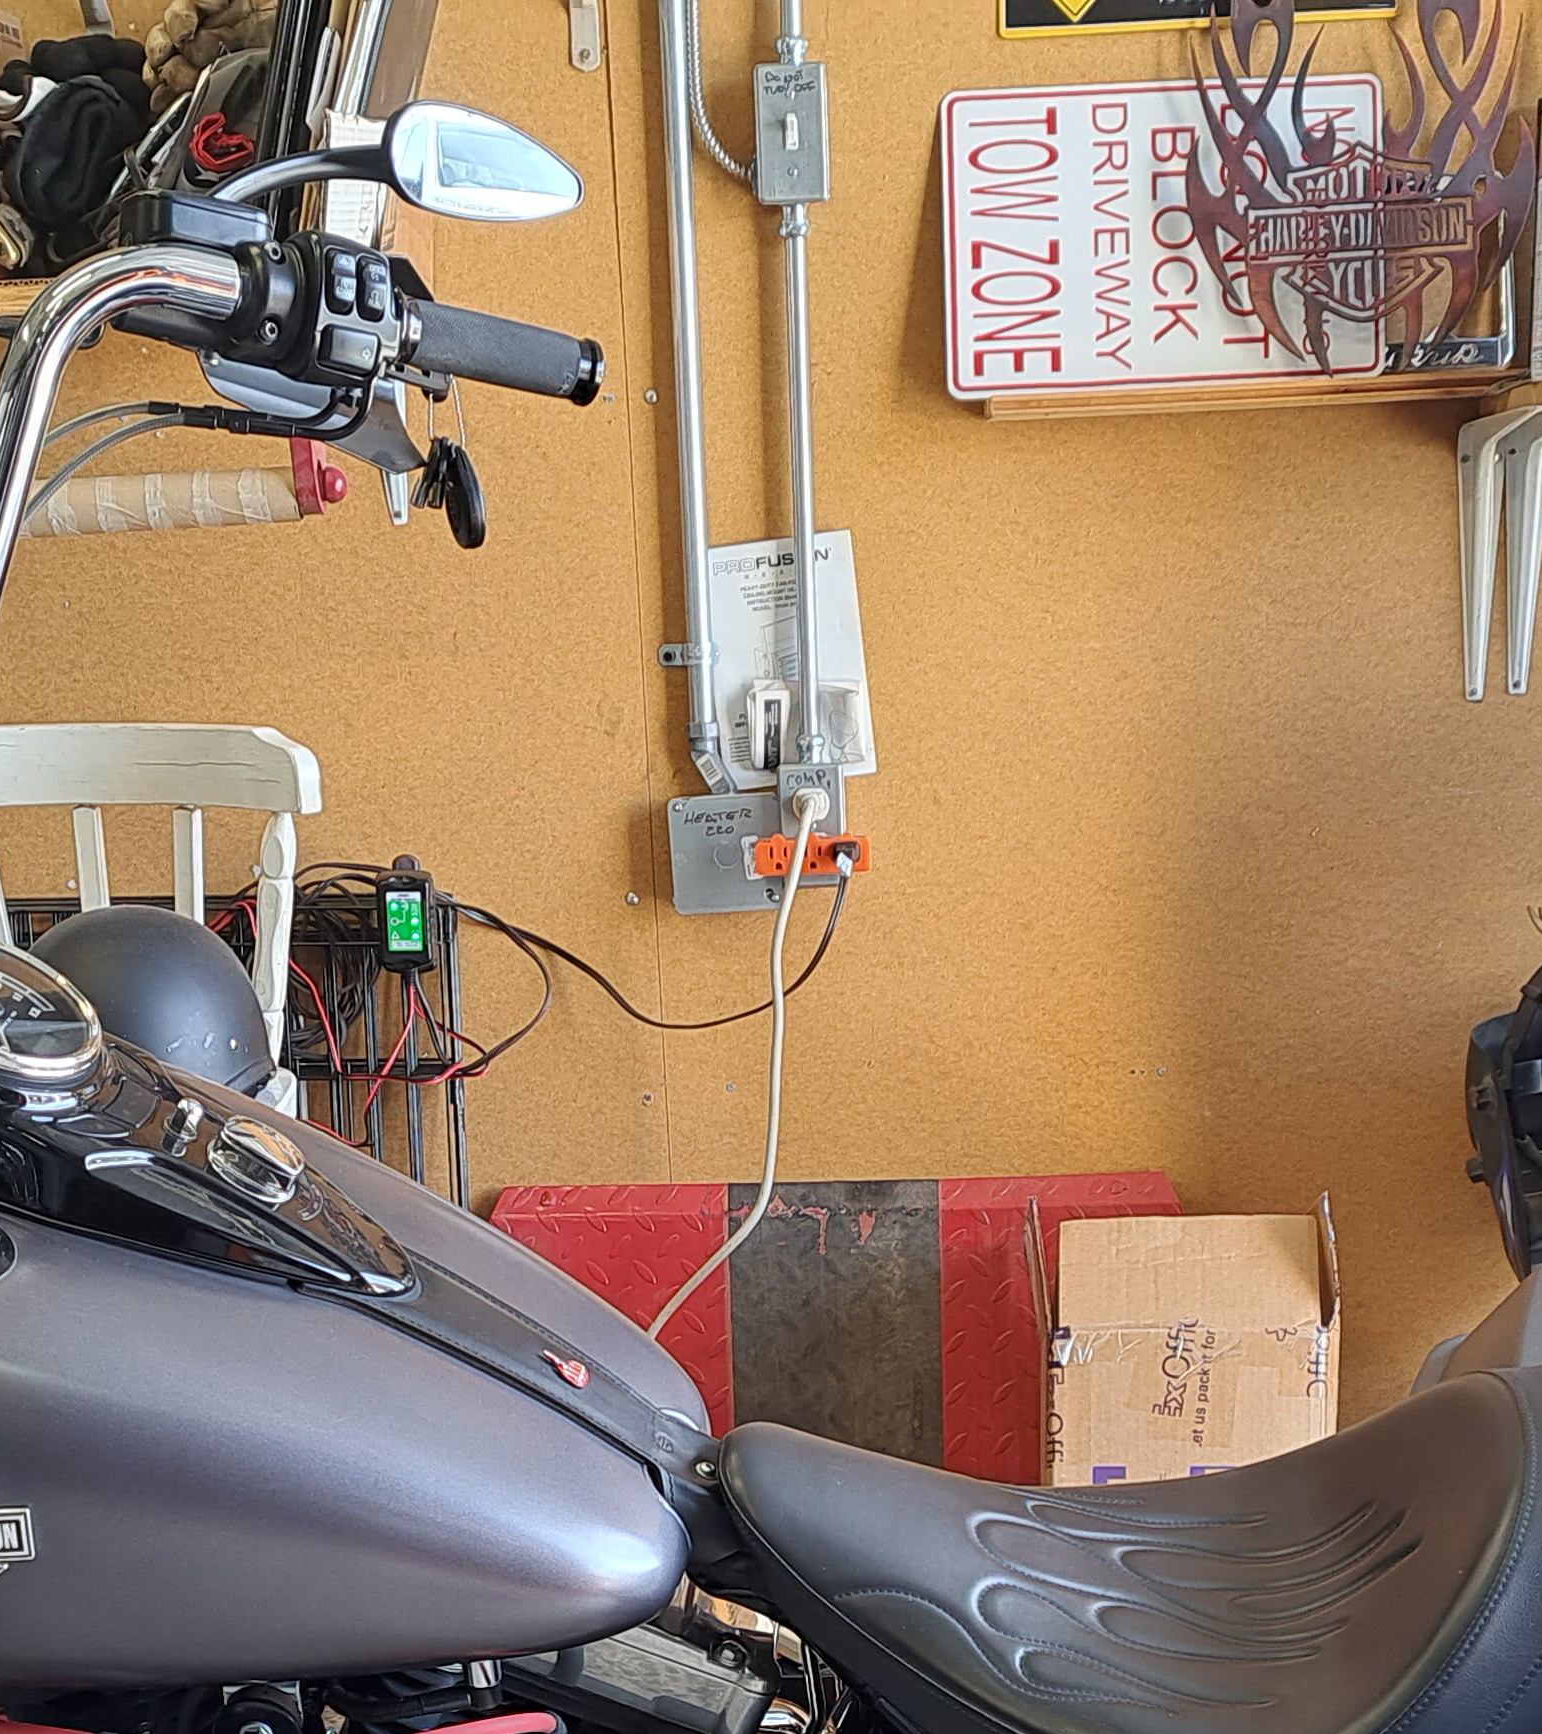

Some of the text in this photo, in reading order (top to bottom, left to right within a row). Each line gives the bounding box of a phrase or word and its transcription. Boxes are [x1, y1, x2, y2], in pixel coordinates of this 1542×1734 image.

[967, 106, 1063, 378] TOW ZONE
[1090, 101, 1134, 371] DRIVEWAY
[1148, 125, 1199, 345] BLOCK
[712, 548, 830, 576] PROFUSN
[683, 807, 753, 826] HEATER
[1202, 1328, 1217, 1350] for
[1197, 1364, 1212, 1404] pack
[1195, 1406, 1206, 1426] us
